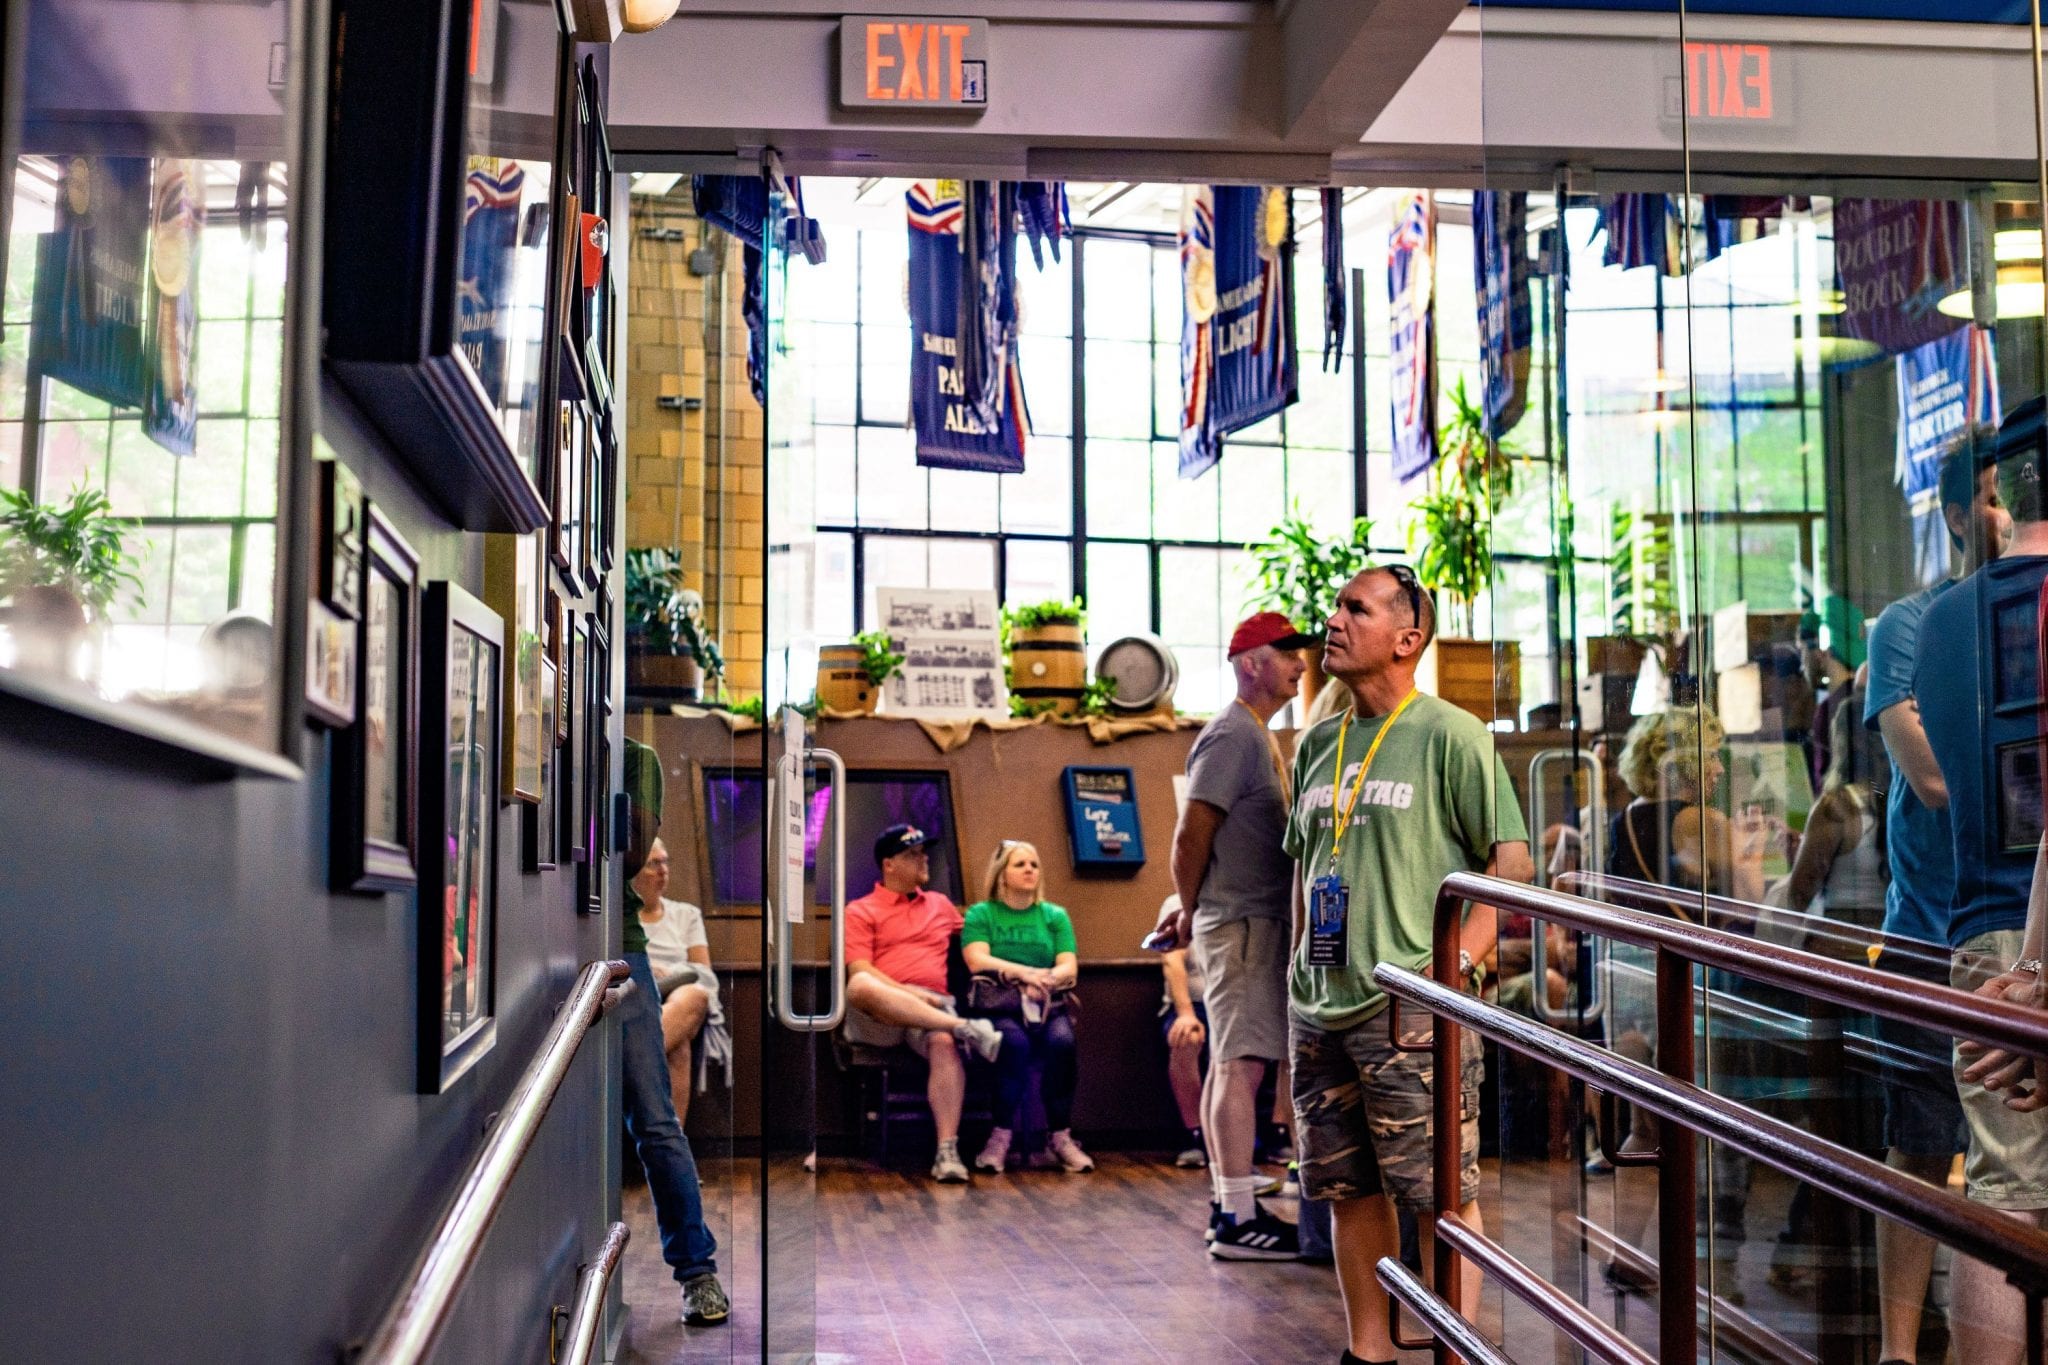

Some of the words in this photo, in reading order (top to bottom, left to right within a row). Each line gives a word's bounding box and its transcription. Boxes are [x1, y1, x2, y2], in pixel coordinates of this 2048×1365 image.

[866, 23, 971, 100] EXIT
[1846, 269, 1907, 314] BOCK
[937, 364, 966, 397] PAL
[1908, 400, 1966, 449] PORTER
[1362, 780, 1415, 810] TAG
